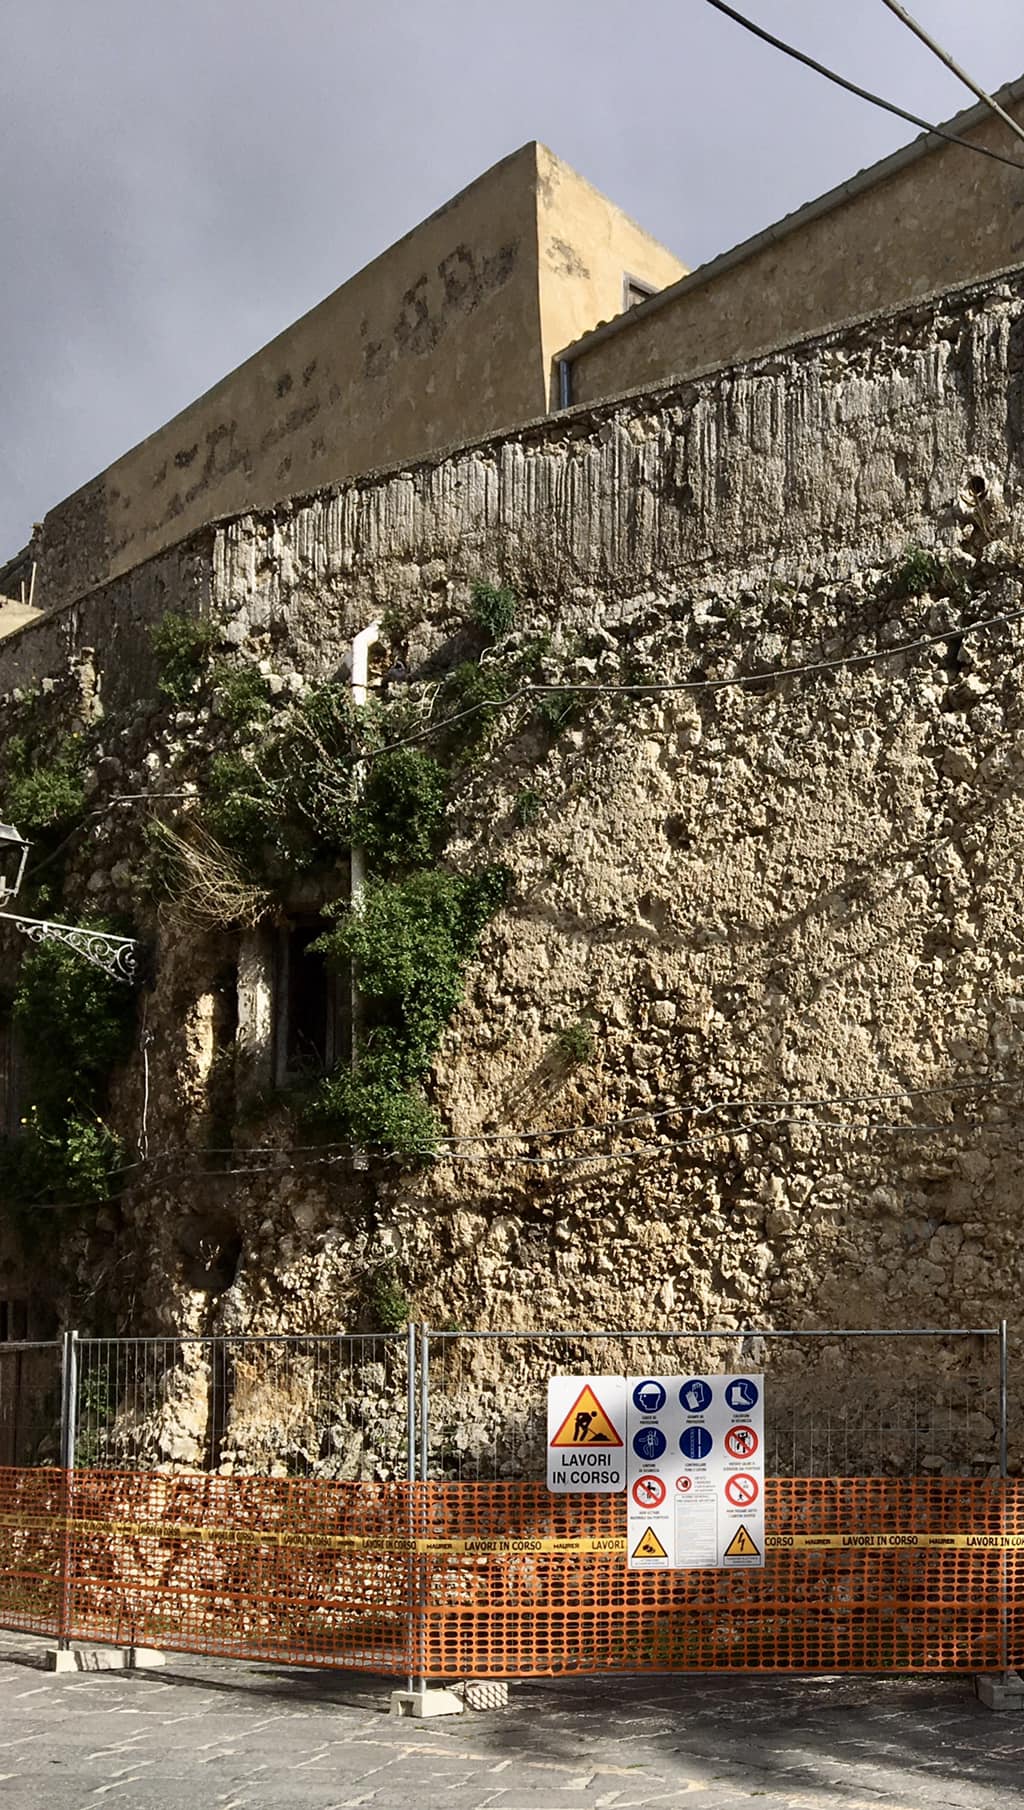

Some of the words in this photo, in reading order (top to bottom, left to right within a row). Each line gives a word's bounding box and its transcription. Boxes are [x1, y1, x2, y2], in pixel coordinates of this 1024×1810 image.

[561, 1453, 611, 1467] LAVORI
[552, 1471, 566, 1484] IN
[570, 1471, 620, 1484] CORSO
[592, 1540, 625, 1550] LAVORI
[765, 1536, 794, 1546] CORSO
[842, 1536, 875, 1546] LAVORI
[877, 1536, 887, 1546] IN
[889, 1535, 918, 1545] CORSO
[966, 1536, 999, 1546] LAVORI
[999, 1536, 1010, 1546] IN
[464, 1541, 497, 1551] LAVORI
[499, 1541, 510, 1551] IN
[511, 1541, 542, 1551] CORSO
